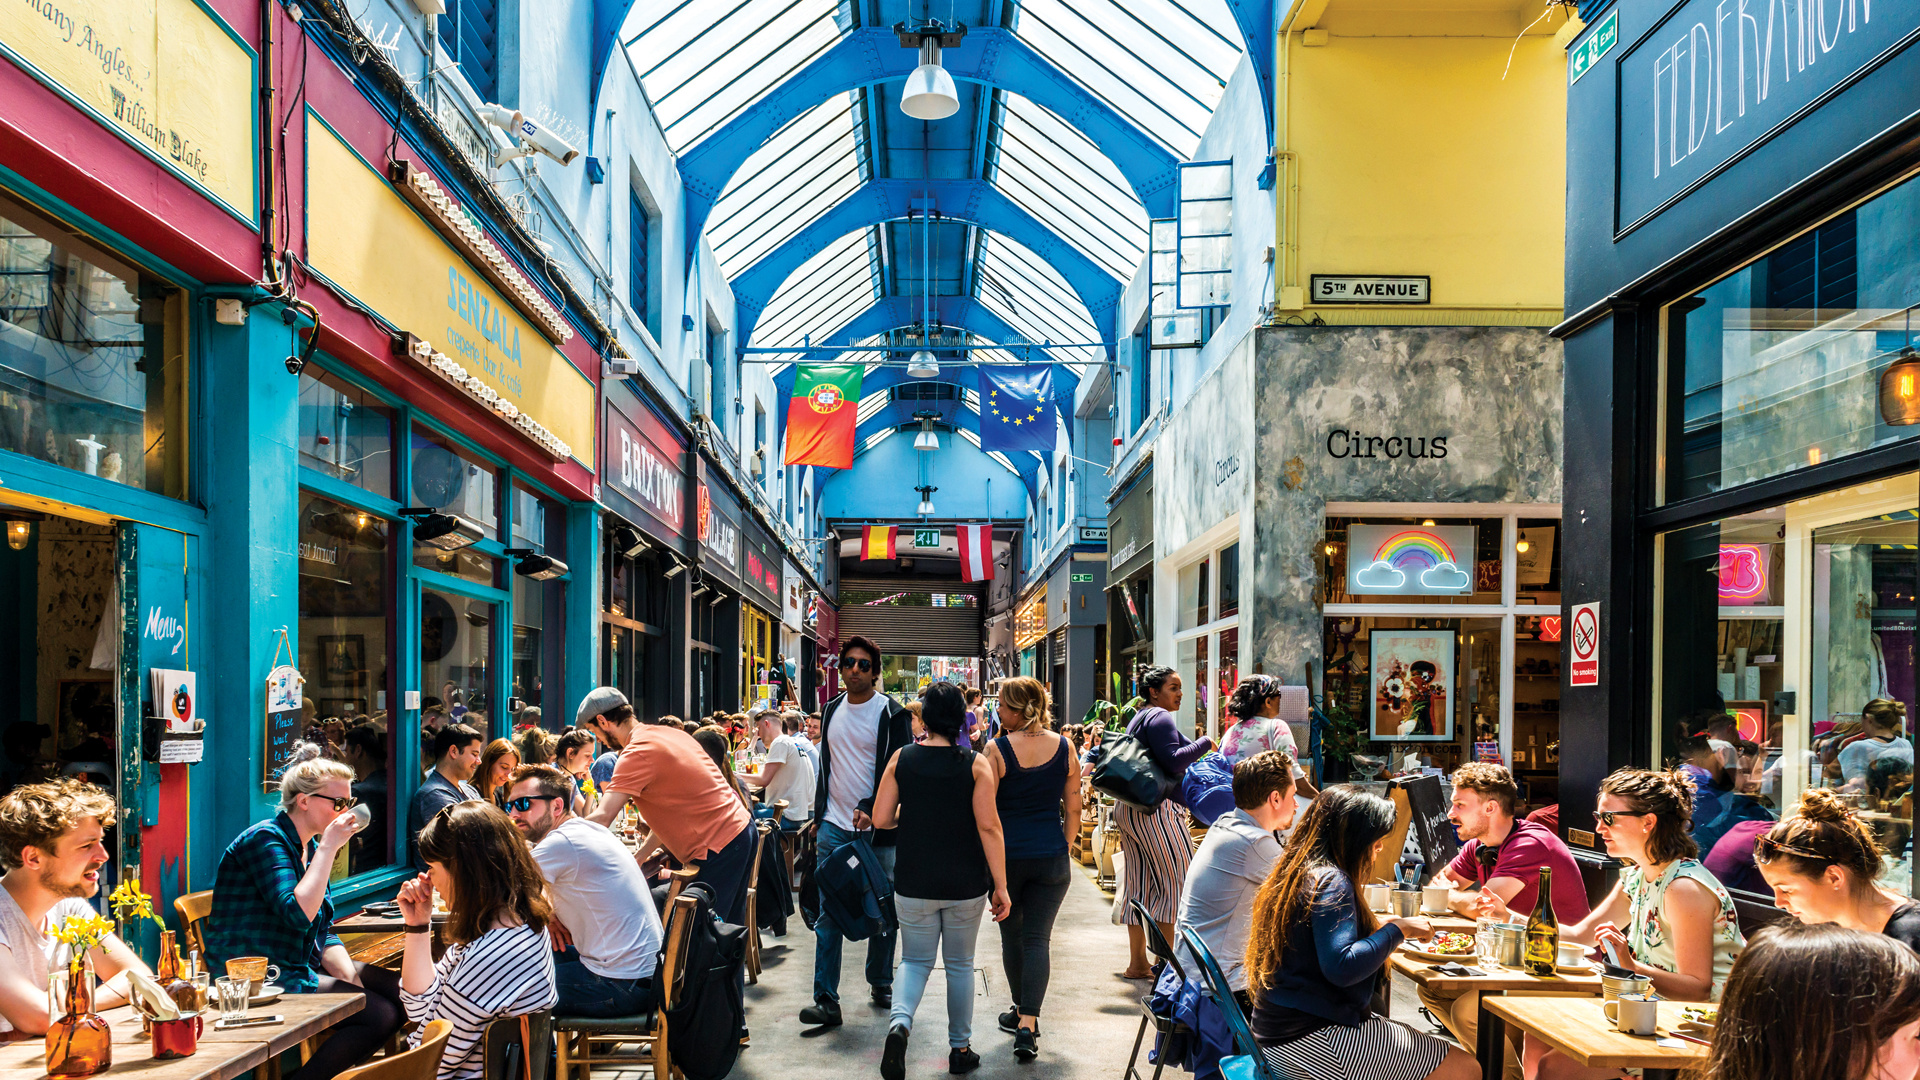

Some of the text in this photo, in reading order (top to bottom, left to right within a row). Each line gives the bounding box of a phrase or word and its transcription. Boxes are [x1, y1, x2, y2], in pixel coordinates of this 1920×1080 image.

[1600, 25, 1614, 47] Exit
[109, 84, 208, 182] William Blake
[522, 122, 536, 135] ADT
[1322, 282, 1419, 296] 5TH AVENUE
[448, 265, 522, 369] SENZALA
[447, 326, 480, 365] creperie
[483, 348, 497, 378] bar
[499, 362, 505, 386] &
[1327, 429, 1448, 459] Circus
[620, 427, 679, 524] BRIXTON
[1215, 453, 1240, 487] Circus
[144, 606, 176, 640] Menu
[1579, 668, 1597, 677] smoking
[275, 713, 294, 730] Please
[273, 732, 288, 746] wait
[274, 750, 281, 761] to
